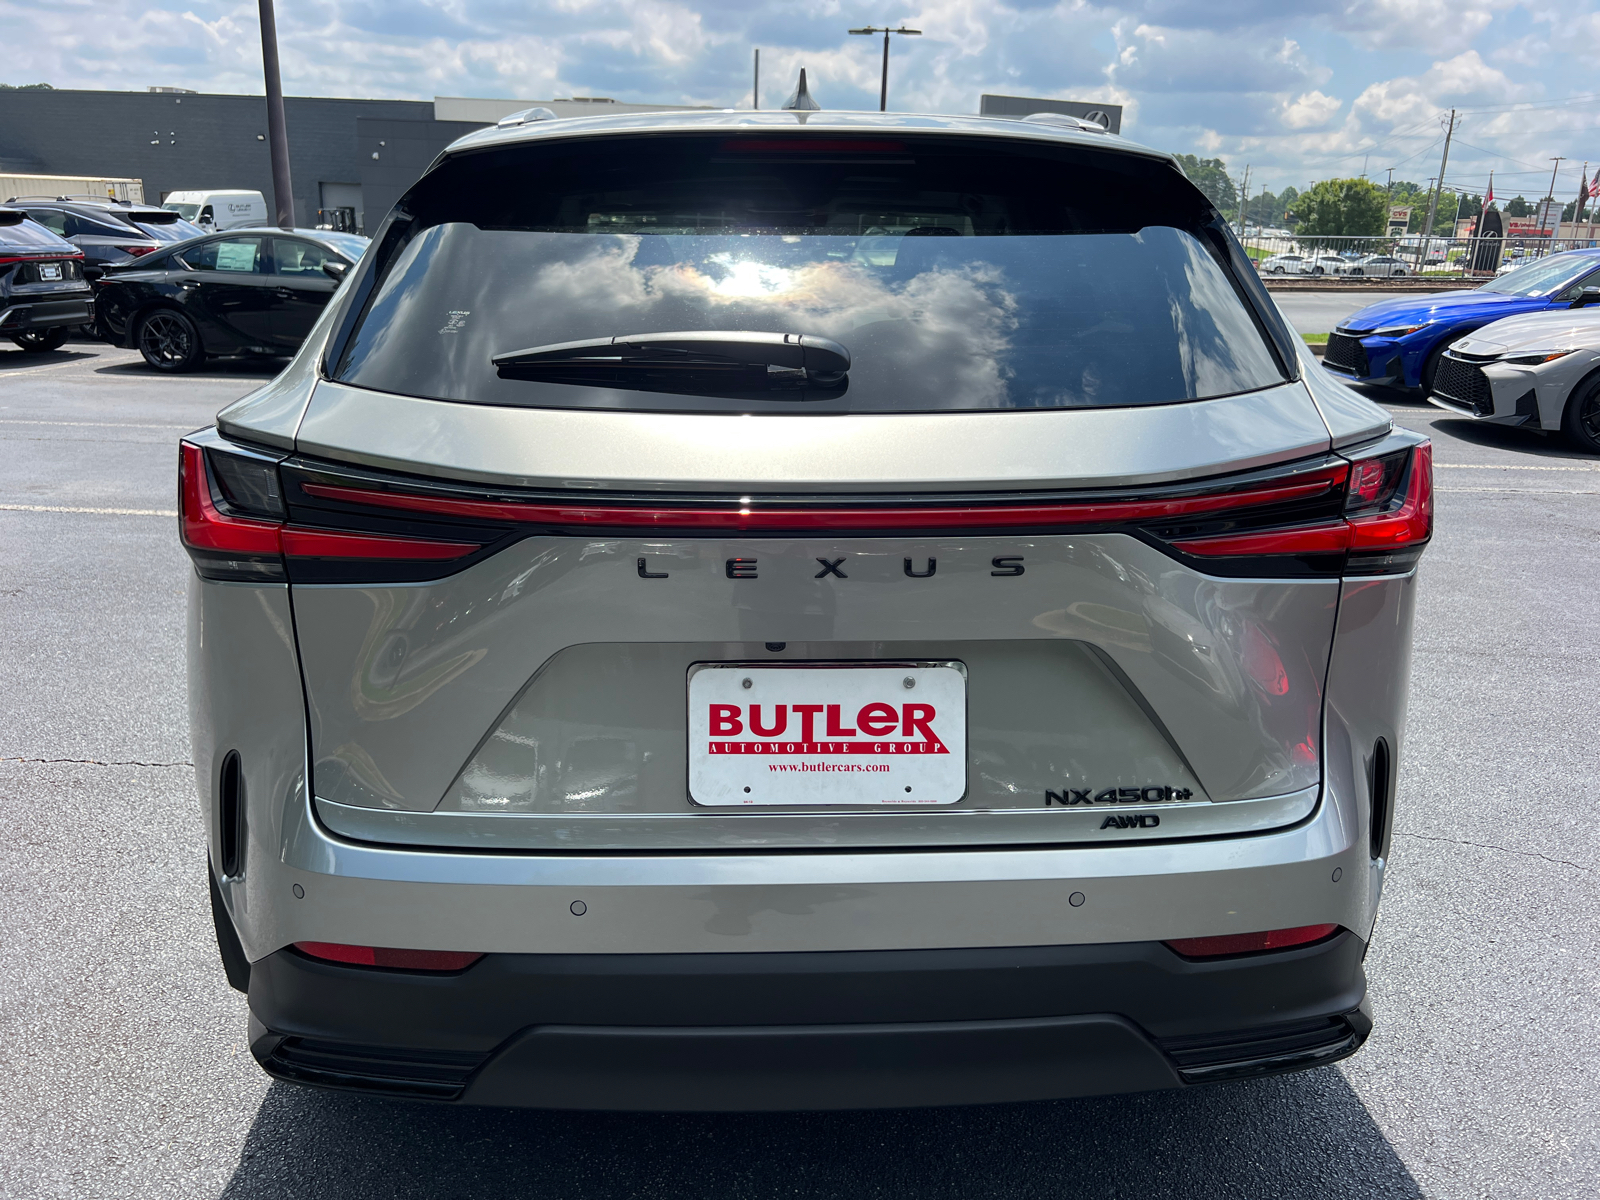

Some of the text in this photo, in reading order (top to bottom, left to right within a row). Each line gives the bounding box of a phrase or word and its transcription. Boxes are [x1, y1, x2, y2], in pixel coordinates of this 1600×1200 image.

[636, 554, 1026, 580] LEXUS
[710, 742, 941, 753] AUTOMOTIVE GROUP
[768, 761, 890, 773] www.butlercars.com
[1045, 785, 1194, 806] NX450h+
[1100, 813, 1160, 830] AWD
